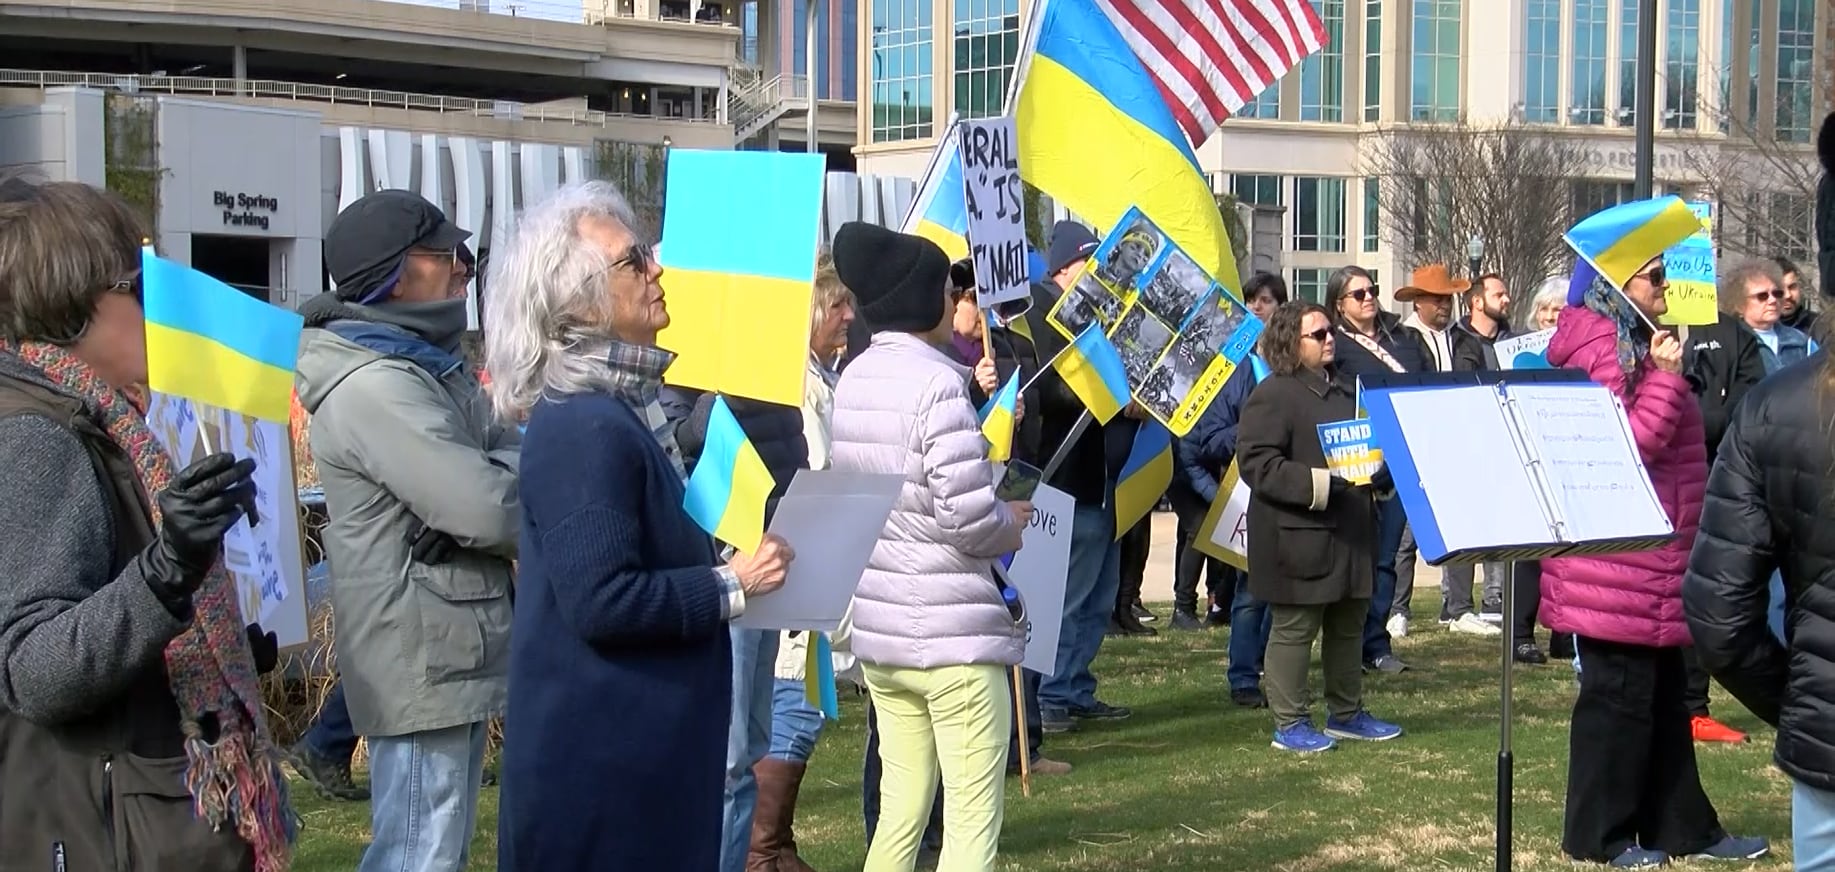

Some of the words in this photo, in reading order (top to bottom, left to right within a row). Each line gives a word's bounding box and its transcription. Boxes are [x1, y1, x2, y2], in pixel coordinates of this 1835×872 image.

[214, 190, 234, 209] Big
[238, 192, 278, 211] Spring
[993, 173, 1022, 225] IS
[223, 211, 269, 230] Parking
[1324, 424, 1372, 444] STAND
[1331, 443, 1368, 463] WITH
